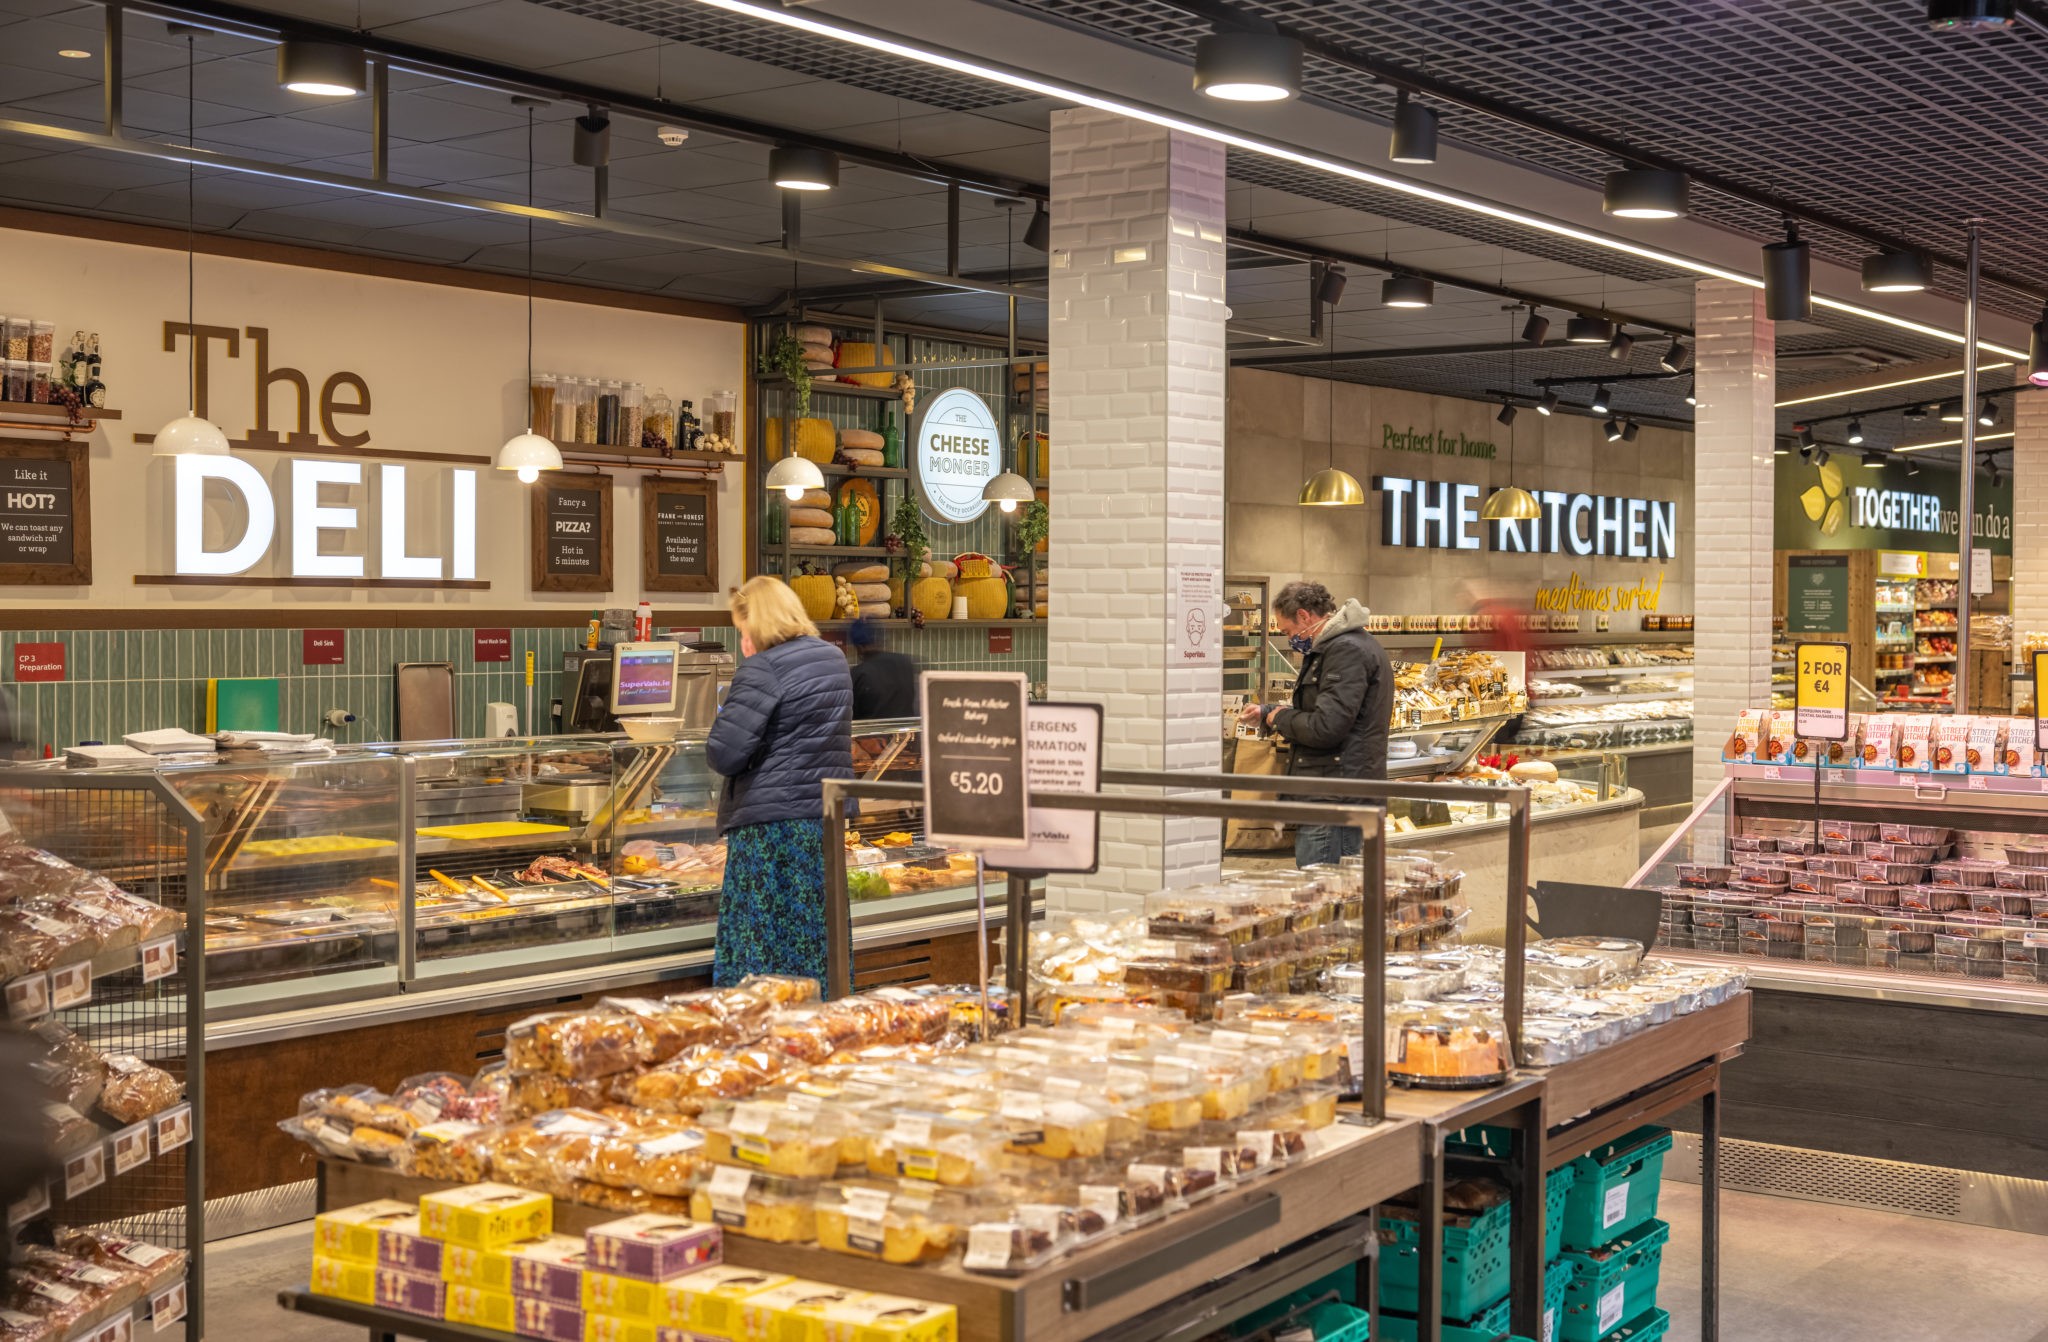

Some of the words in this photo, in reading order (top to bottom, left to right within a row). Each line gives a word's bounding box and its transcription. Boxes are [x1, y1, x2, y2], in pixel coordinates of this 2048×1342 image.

[163, 320, 372, 448] The
[955, 413, 967, 423] THE
[930, 433, 990, 456] CHEESE
[1383, 423, 1434, 454] Perfect
[1437, 430, 1457, 456] for
[1460, 432, 1497, 460] home
[929, 456, 990, 477] MONGER
[15, 469, 37, 480] Like
[40, 470, 48, 480] it
[7, 492, 56, 510] HOT?
[558, 497, 580, 508] Fancy
[175, 454, 477, 580] DELI
[1382, 476, 1480, 550] THE
[1855, 486, 1941, 533] TOGETHER
[1940, 509, 1959, 536] we
[1986, 503, 2001, 538] do
[2003, 515, 2011, 539] a
[1, 522, 13, 531] We
[30, 524, 48, 532] toast
[555, 521, 591, 533] PIZZA?
[665, 536, 692, 544] Available
[28, 546, 47, 554] wrap
[562, 546, 575, 554] Hot
[555, 557, 560, 565] 5
[562, 557, 590, 566] minutes
[1535, 571, 1612, 614] mealtimes
[1613, 571, 1665, 613] sorted
[19, 664, 62, 672] Preparation
[1803, 661, 1811, 674] 2
[1814, 662, 1842, 676] FOR
[1814, 680, 1830, 693] €4
[950, 772, 1003, 795] €5.20
